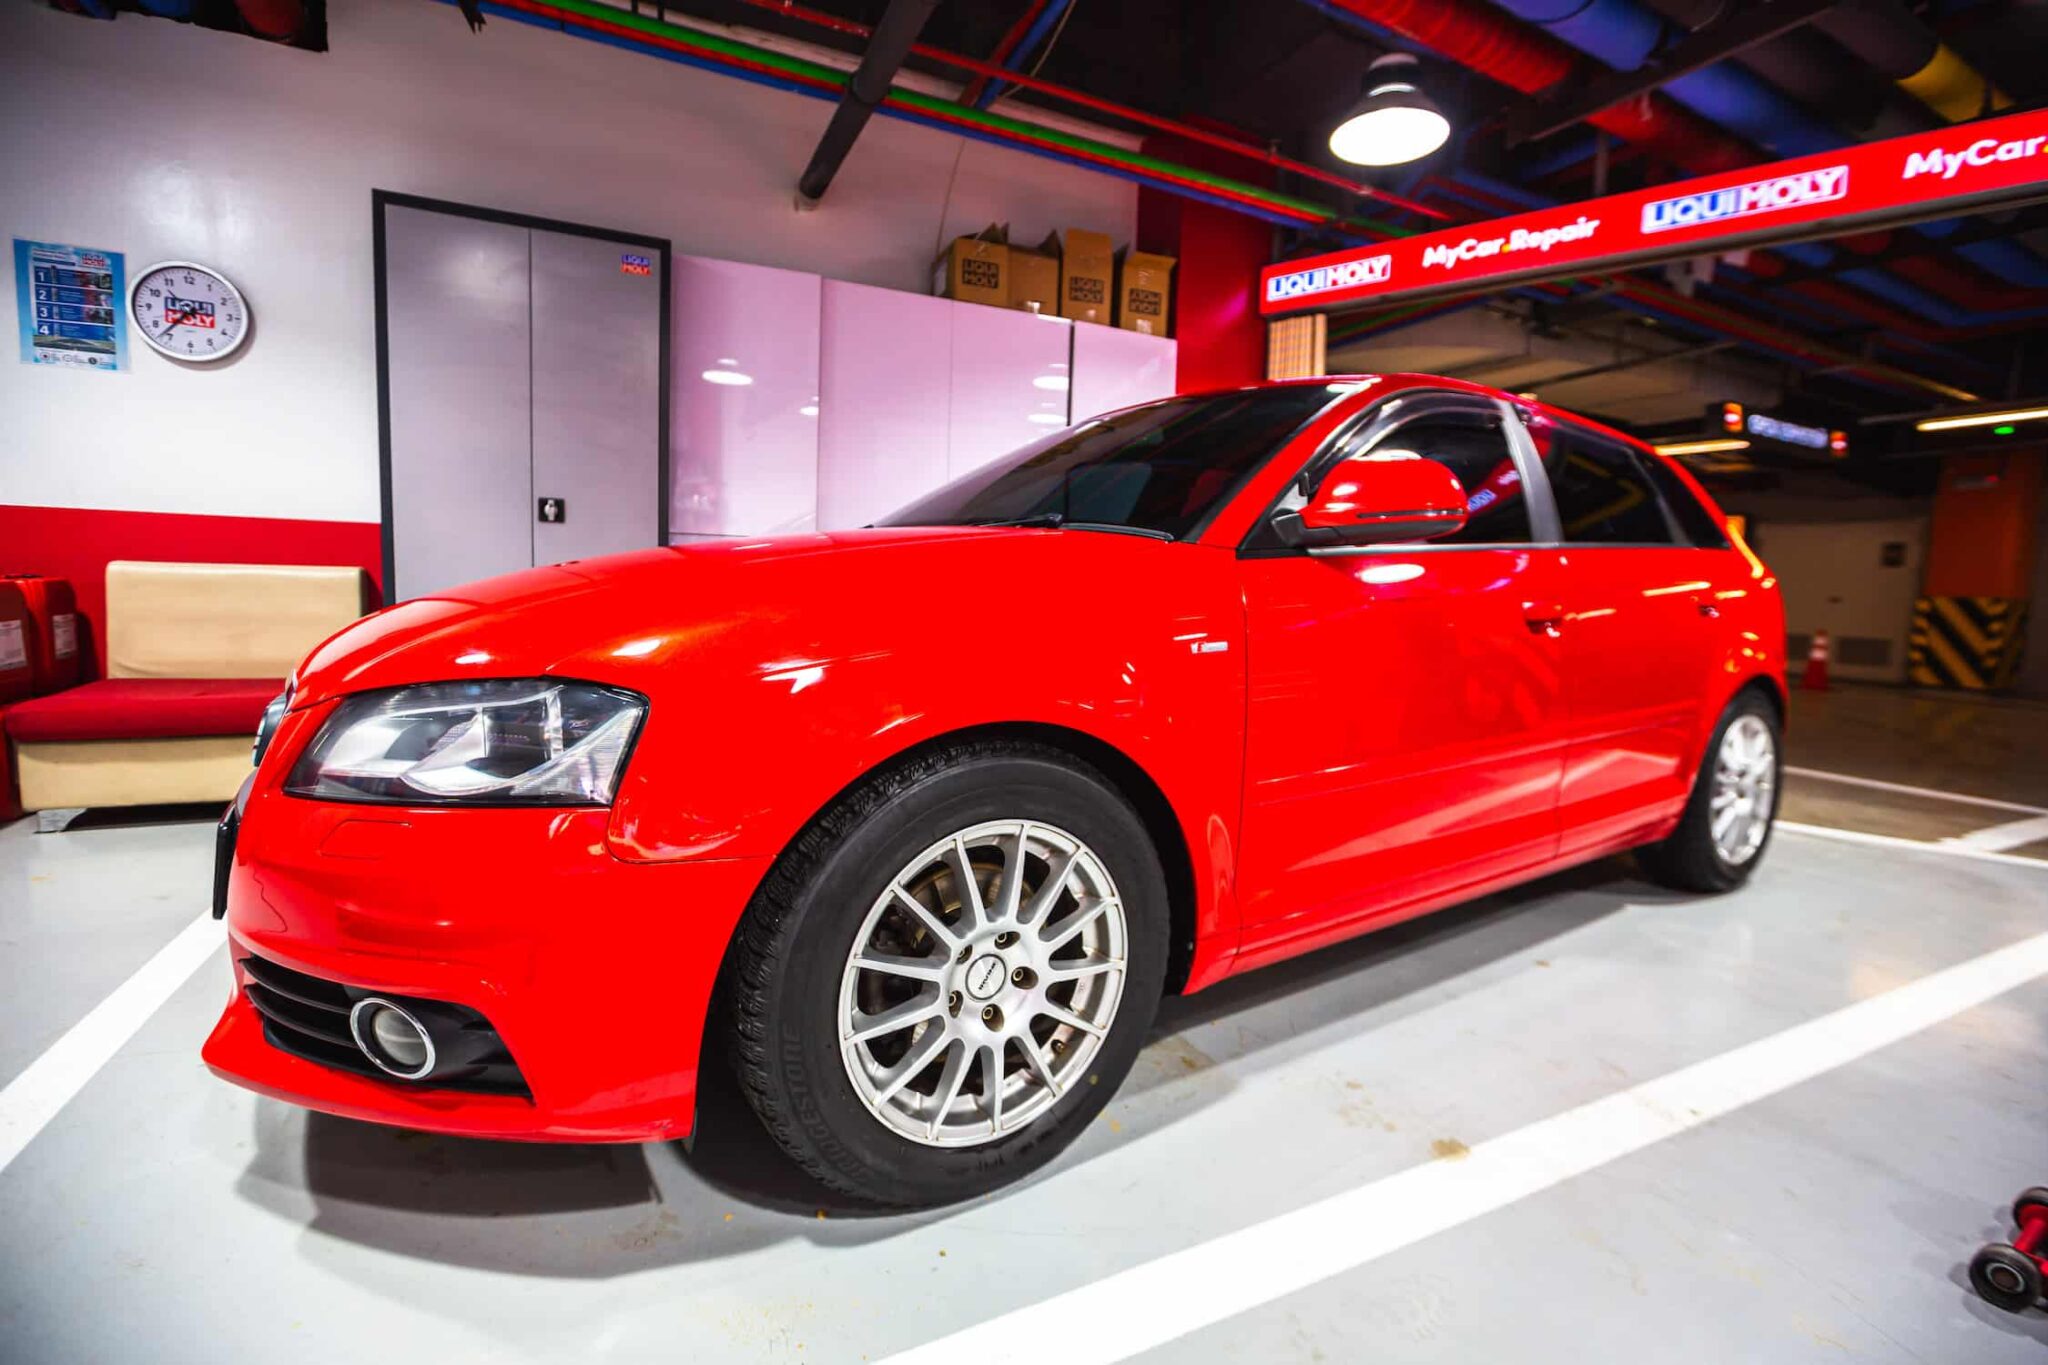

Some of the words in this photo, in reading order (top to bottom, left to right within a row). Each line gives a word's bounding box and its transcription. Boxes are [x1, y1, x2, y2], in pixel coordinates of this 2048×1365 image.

[1645, 188, 1738, 229] LIQUI
[1738, 167, 1847, 211] MOLY
[1422, 216, 1600, 269] MyCar.Repair
[39, 271, 45, 282] 1
[184, 275, 195, 285] 12
[1268, 269, 1326, 299] LIQUI
[1326, 255, 1390, 288] MOLY
[165, 278, 174, 287] 11
[39, 290, 47, 301] 2
[150, 288, 161, 298] 10
[40, 307, 48, 317] 3
[226, 313, 233, 322] 3
[152, 320, 159, 328] 8
[40, 325, 49, 335] 4
